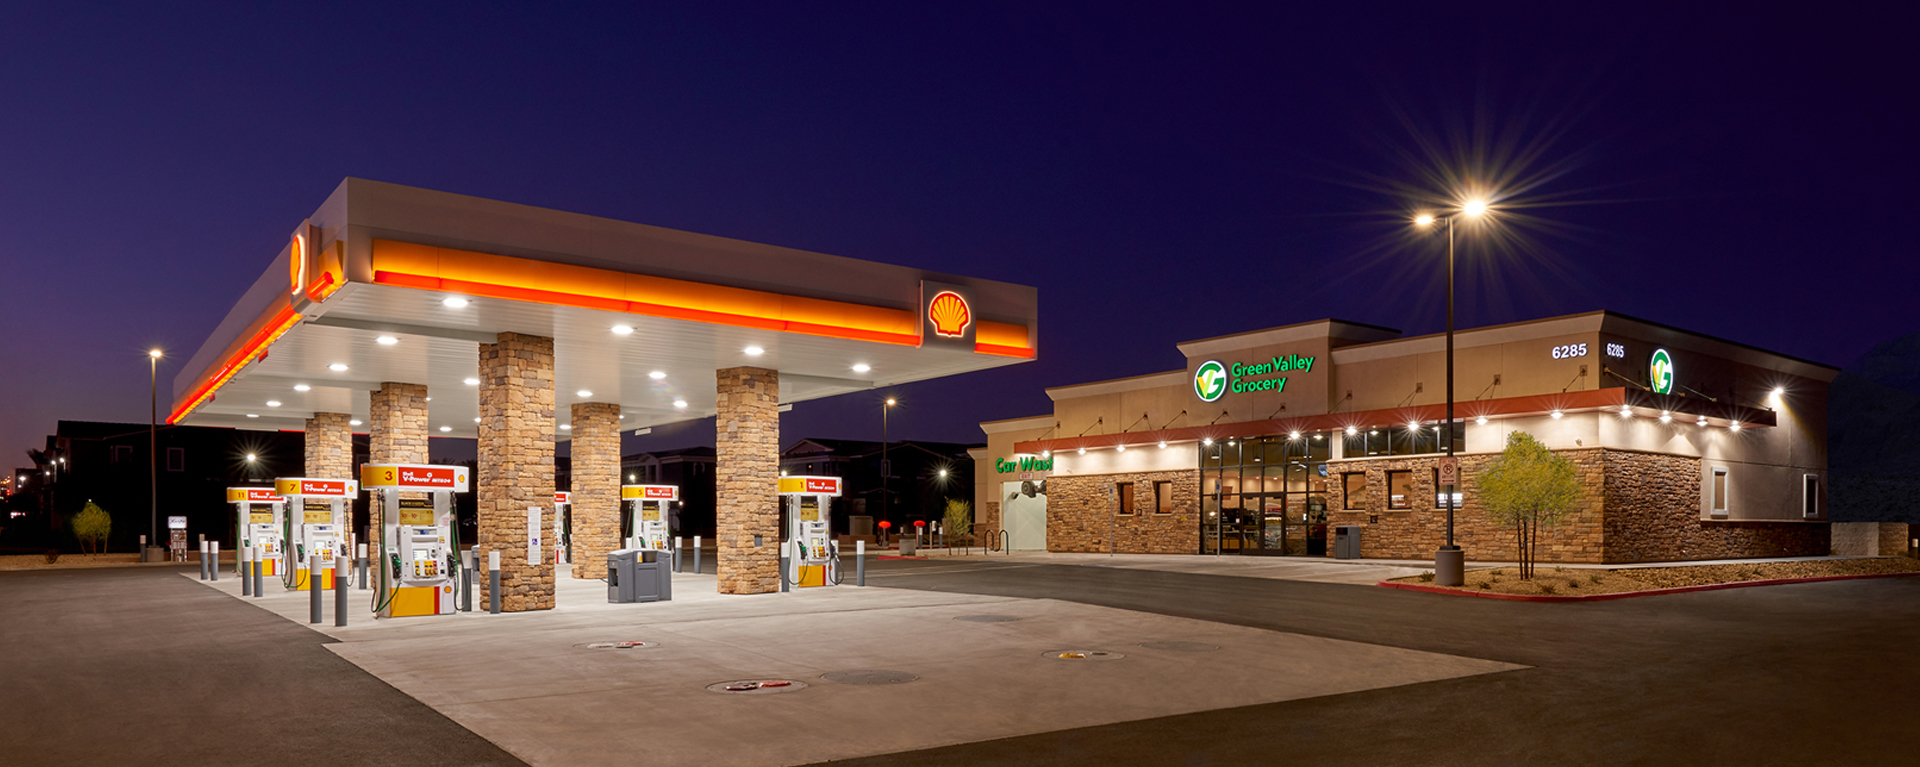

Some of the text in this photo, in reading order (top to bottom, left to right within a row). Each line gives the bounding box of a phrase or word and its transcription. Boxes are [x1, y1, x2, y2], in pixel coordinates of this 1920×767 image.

[1552, 343, 1587, 359] 6285
[1606, 343, 1625, 358] 6285
[1231, 354, 1314, 377] Green Valley
[1231, 377, 1287, 394] Grocery
[995, 457, 1017, 473] Car
[384, 471, 393, 481] 3
